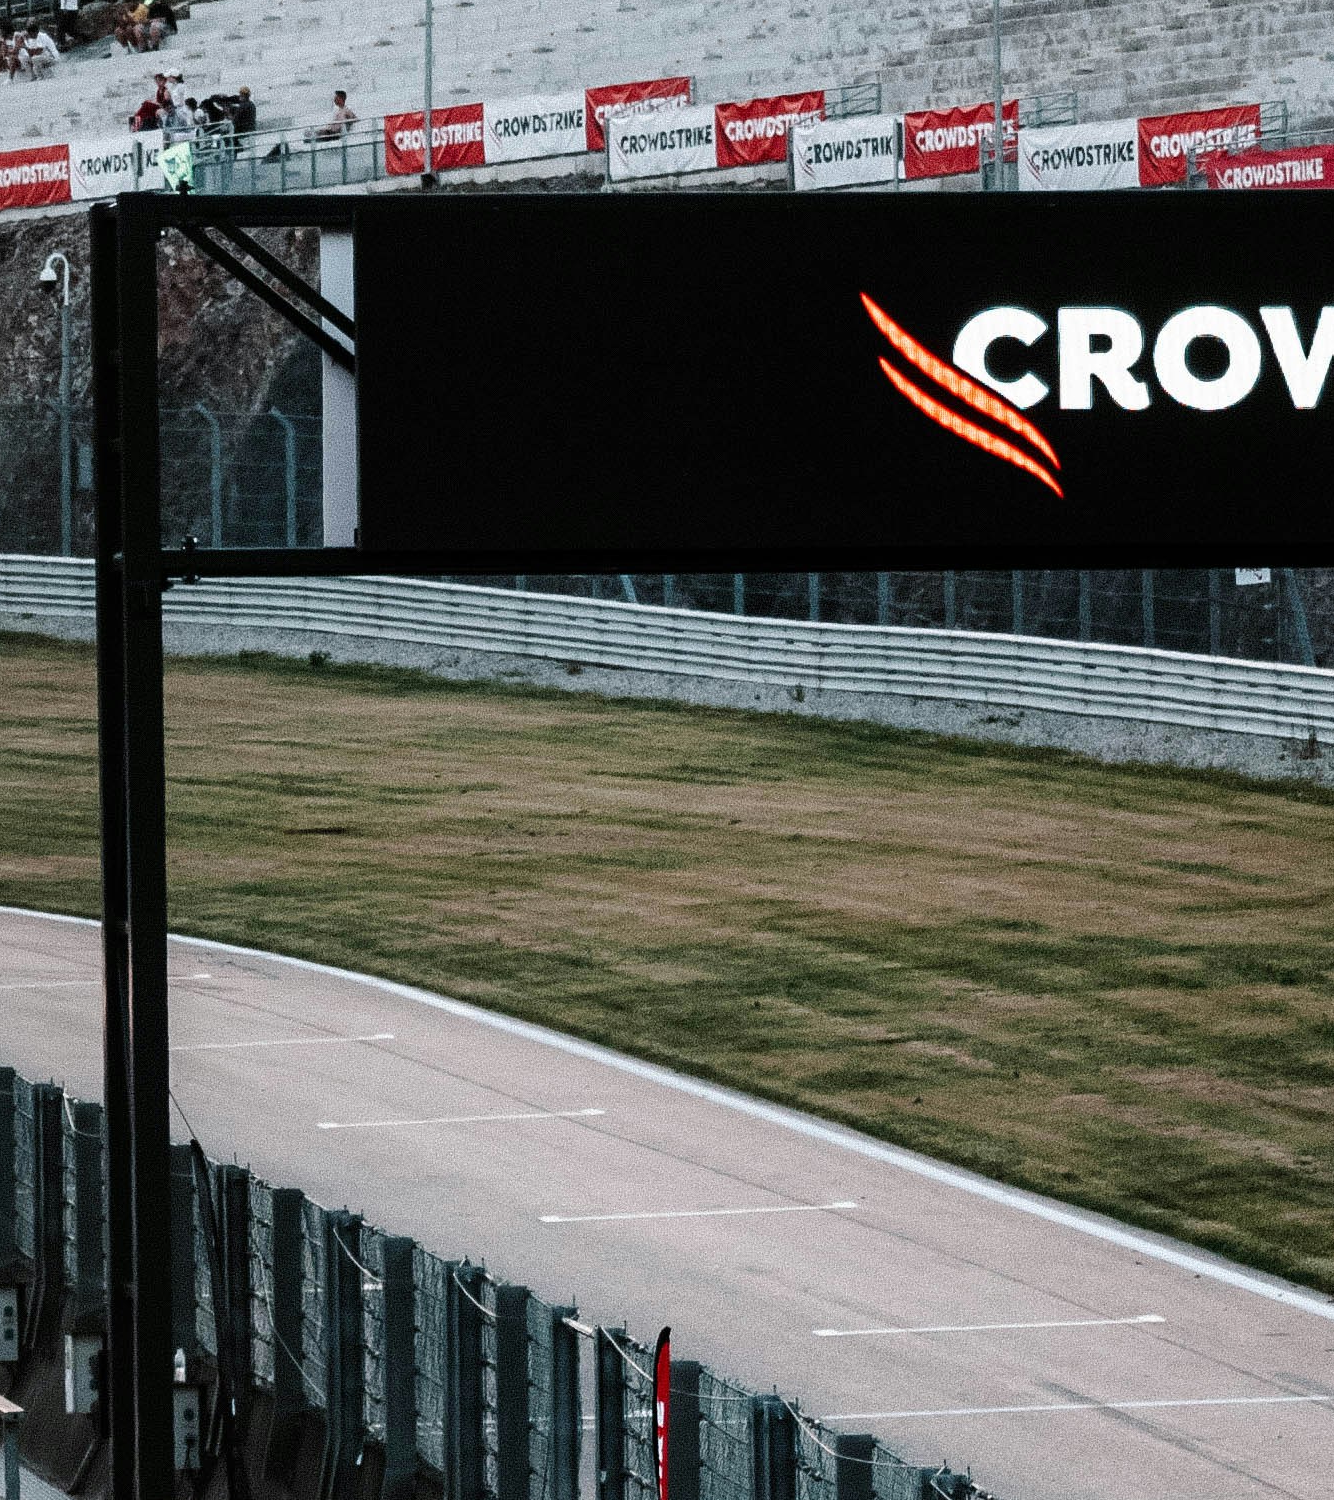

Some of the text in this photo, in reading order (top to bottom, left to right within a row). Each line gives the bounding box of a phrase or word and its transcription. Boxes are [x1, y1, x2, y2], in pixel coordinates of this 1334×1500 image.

[495, 109, 583, 137] CROWDSTRIKE
[621, 125, 713, 154] CROWDSTRIKE
[807, 136, 893, 164] CROWDSTRIK
[80, 148, 160, 177] CROWDSTKE
[1031, 141, 1135, 173] CROWDSTRIKE
[1224, 158, 1324, 189] CROWDSTRIKE
